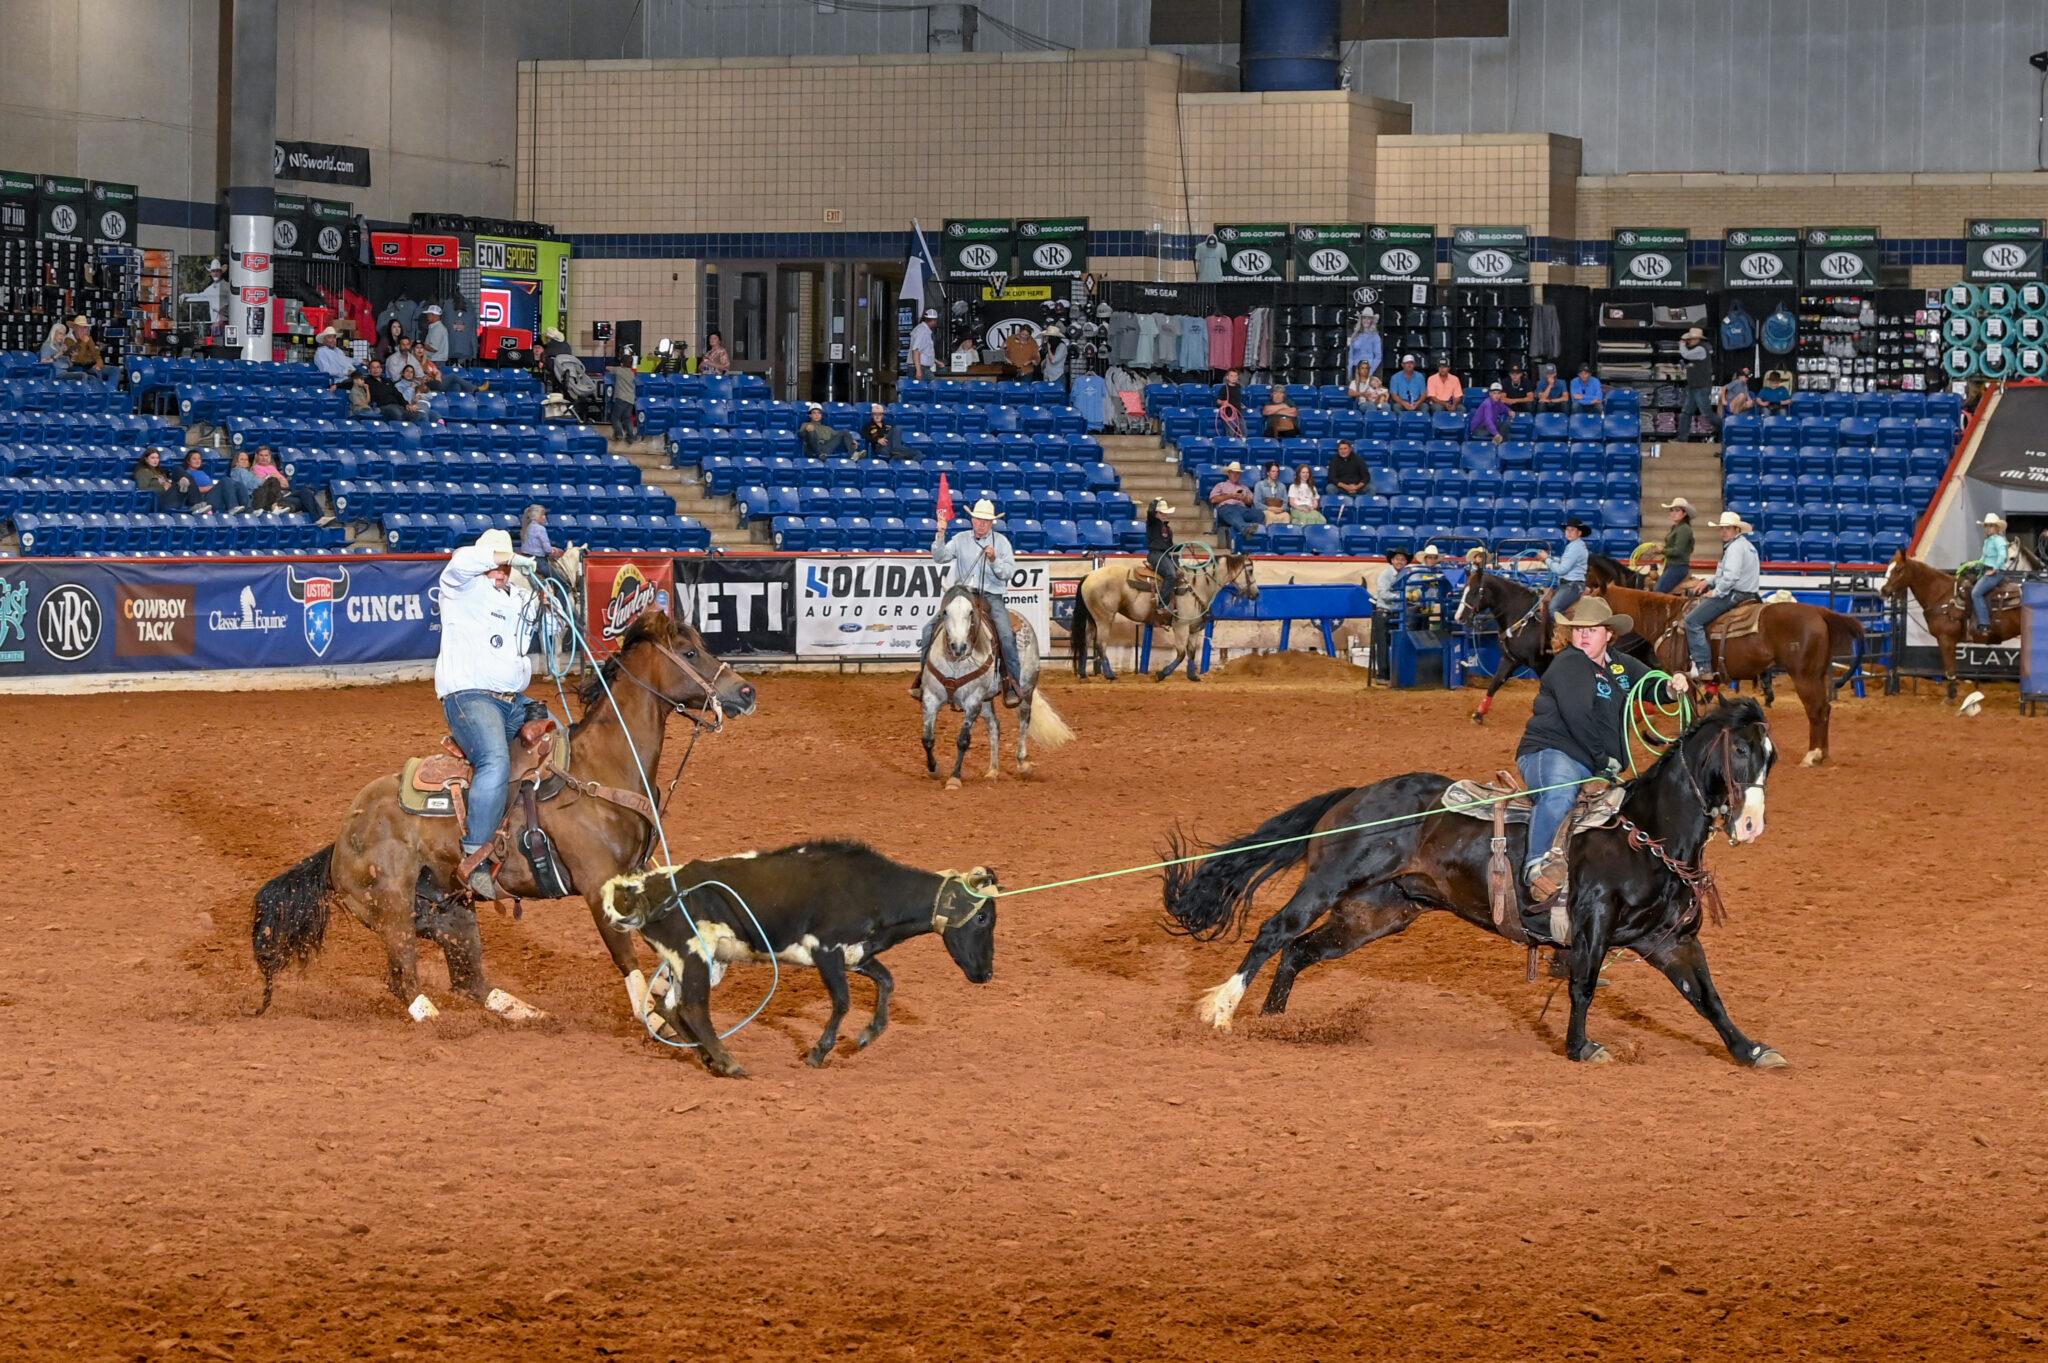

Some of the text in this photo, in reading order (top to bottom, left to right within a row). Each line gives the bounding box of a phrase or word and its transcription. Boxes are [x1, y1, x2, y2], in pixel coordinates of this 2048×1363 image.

[56, 208, 73, 230] NRS
[826, 210, 840, 221] EXIT
[105, 215, 122, 235] NRS
[278, 224, 293, 243] NRS
[949, 225, 965, 235] NRS
[1022, 225, 1038, 235] NRS
[1221, 228, 1238, 240] NRS
[1371, 228, 1387, 240] NRS
[1974, 223, 1991, 236] NRS
[322, 230, 338, 249] NRS
[1299, 229, 1316, 240] NRS
[1458, 230, 1476, 242] NRS
[1619, 232, 1637, 244] NRS
[1730, 232, 1749, 244] NRS
[1809, 231, 1827, 243] NRS
[478, 244, 535, 270] EQN SPORTS
[966, 248, 990, 266] NRS
[1040, 247, 1064, 265] NRS
[1239, 253, 1264, 270] NRS
[1316, 252, 1341, 270] NRS
[1387, 252, 1413, 271] NRS
[1476, 254, 1504, 272] NRS
[1990, 247, 2018, 266] NRS
[1637, 257, 1663, 275] NRS
[1748, 256, 1775, 275] NRS
[1828, 256, 1855, 275] NRS
[1972, 270, 2037, 278] NRSworld.com
[1159, 289, 1178, 297] GEAR
[1357, 289, 1375, 303] NRS
[306, 583, 331, 598] USTRC
[805, 566, 951, 598] HOLIDAY
[1055, 583, 1078, 593] USTR
[124, 598, 187, 619] COWBOY
[347, 594, 424, 622] CINCH
[675, 582, 783, 633] YETI
[805, 605, 936, 617] AUTO GROU
[46, 591, 92, 650] NRS
[209, 609, 287, 634] Classic Equine
[137, 621, 175, 641] TACK
